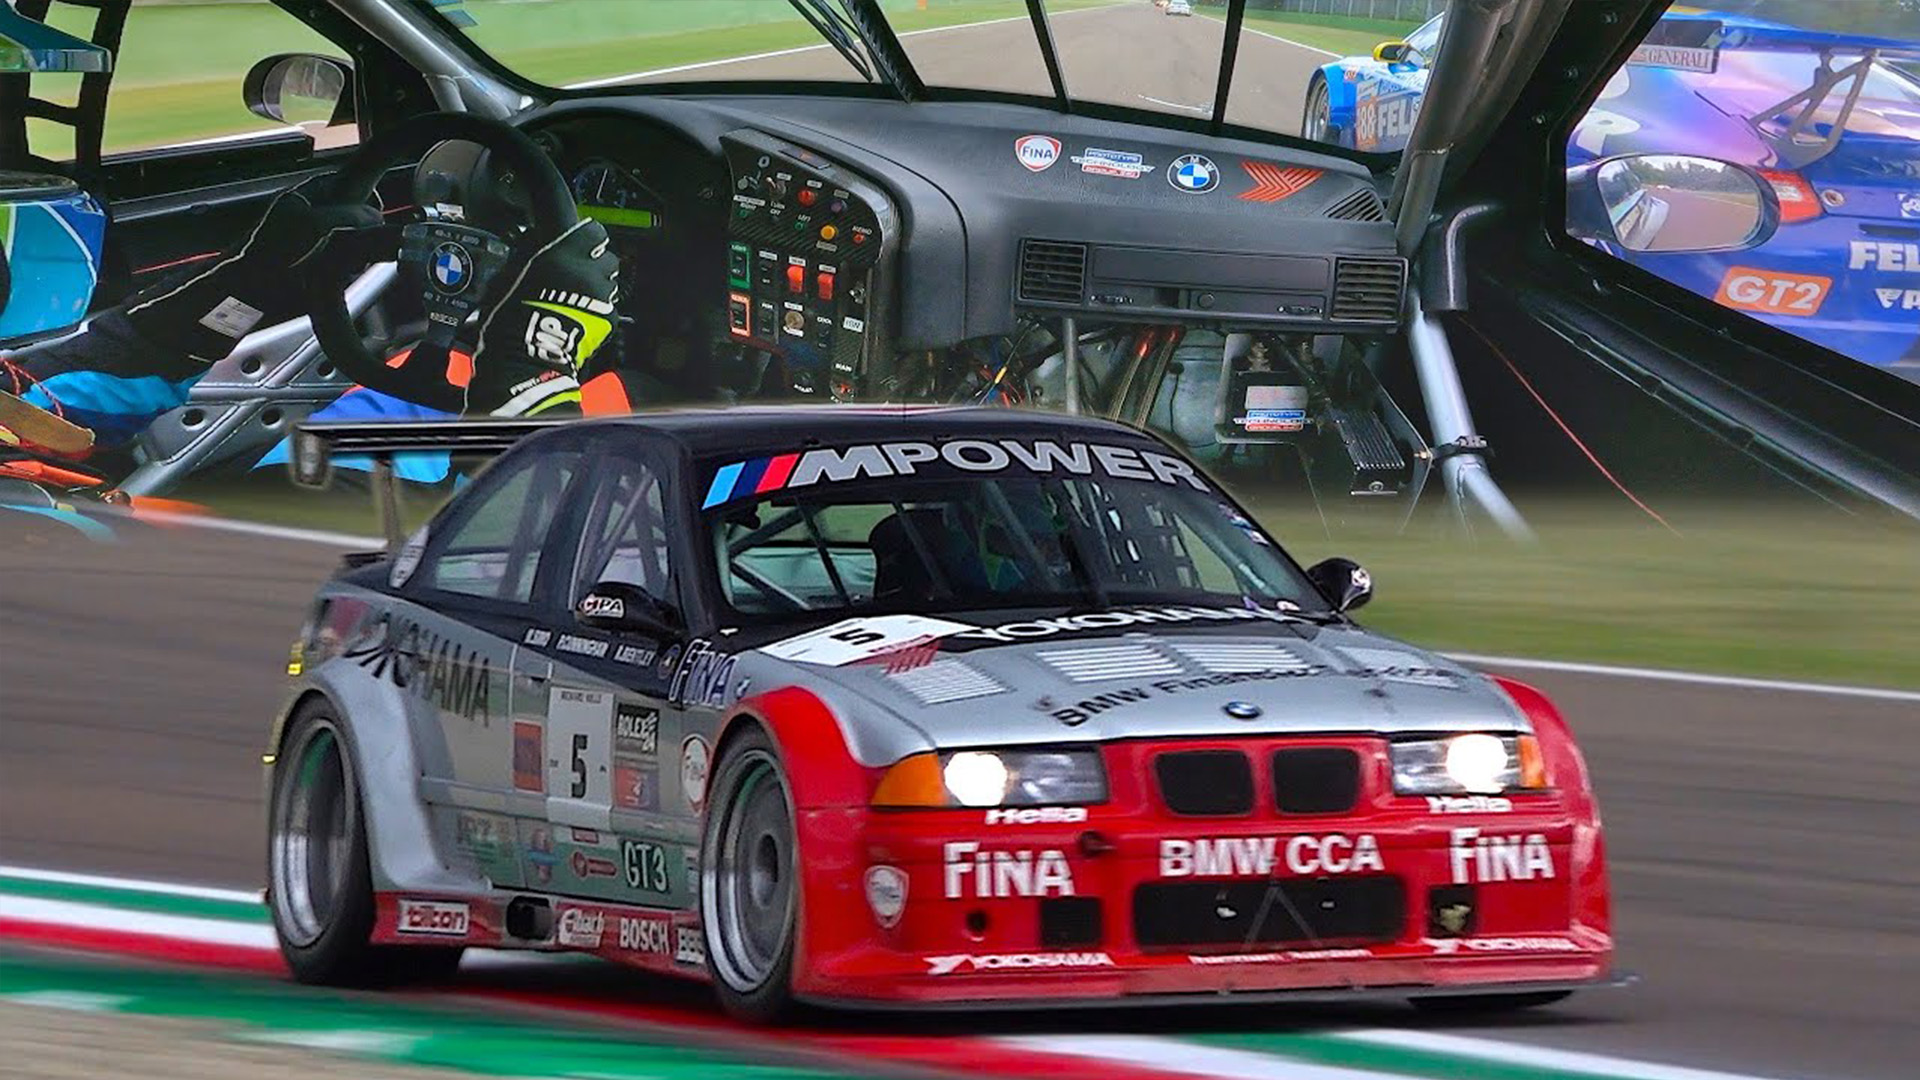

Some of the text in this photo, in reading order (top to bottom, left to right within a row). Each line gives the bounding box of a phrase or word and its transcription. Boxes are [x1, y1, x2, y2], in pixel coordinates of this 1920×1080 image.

[1648, 49, 1710, 69] GENERALI
[1022, 145, 1054, 160] FINA
[1727, 275, 1821, 310] GT2
[787, 441, 1210, 493] MPOWER
[829, 627, 885, 646] 5
[669, 638, 738, 709] FINA
[1052, 687, 1152, 727] BMW
[571, 734, 588, 798] 5
[985, 807, 1088, 825] Hella
[1424, 796, 1513, 814] Hella
[624, 841, 668, 892] GT3
[1160, 834, 1385, 876] BMW CCA
[620, 917, 670, 955] BOSCH
